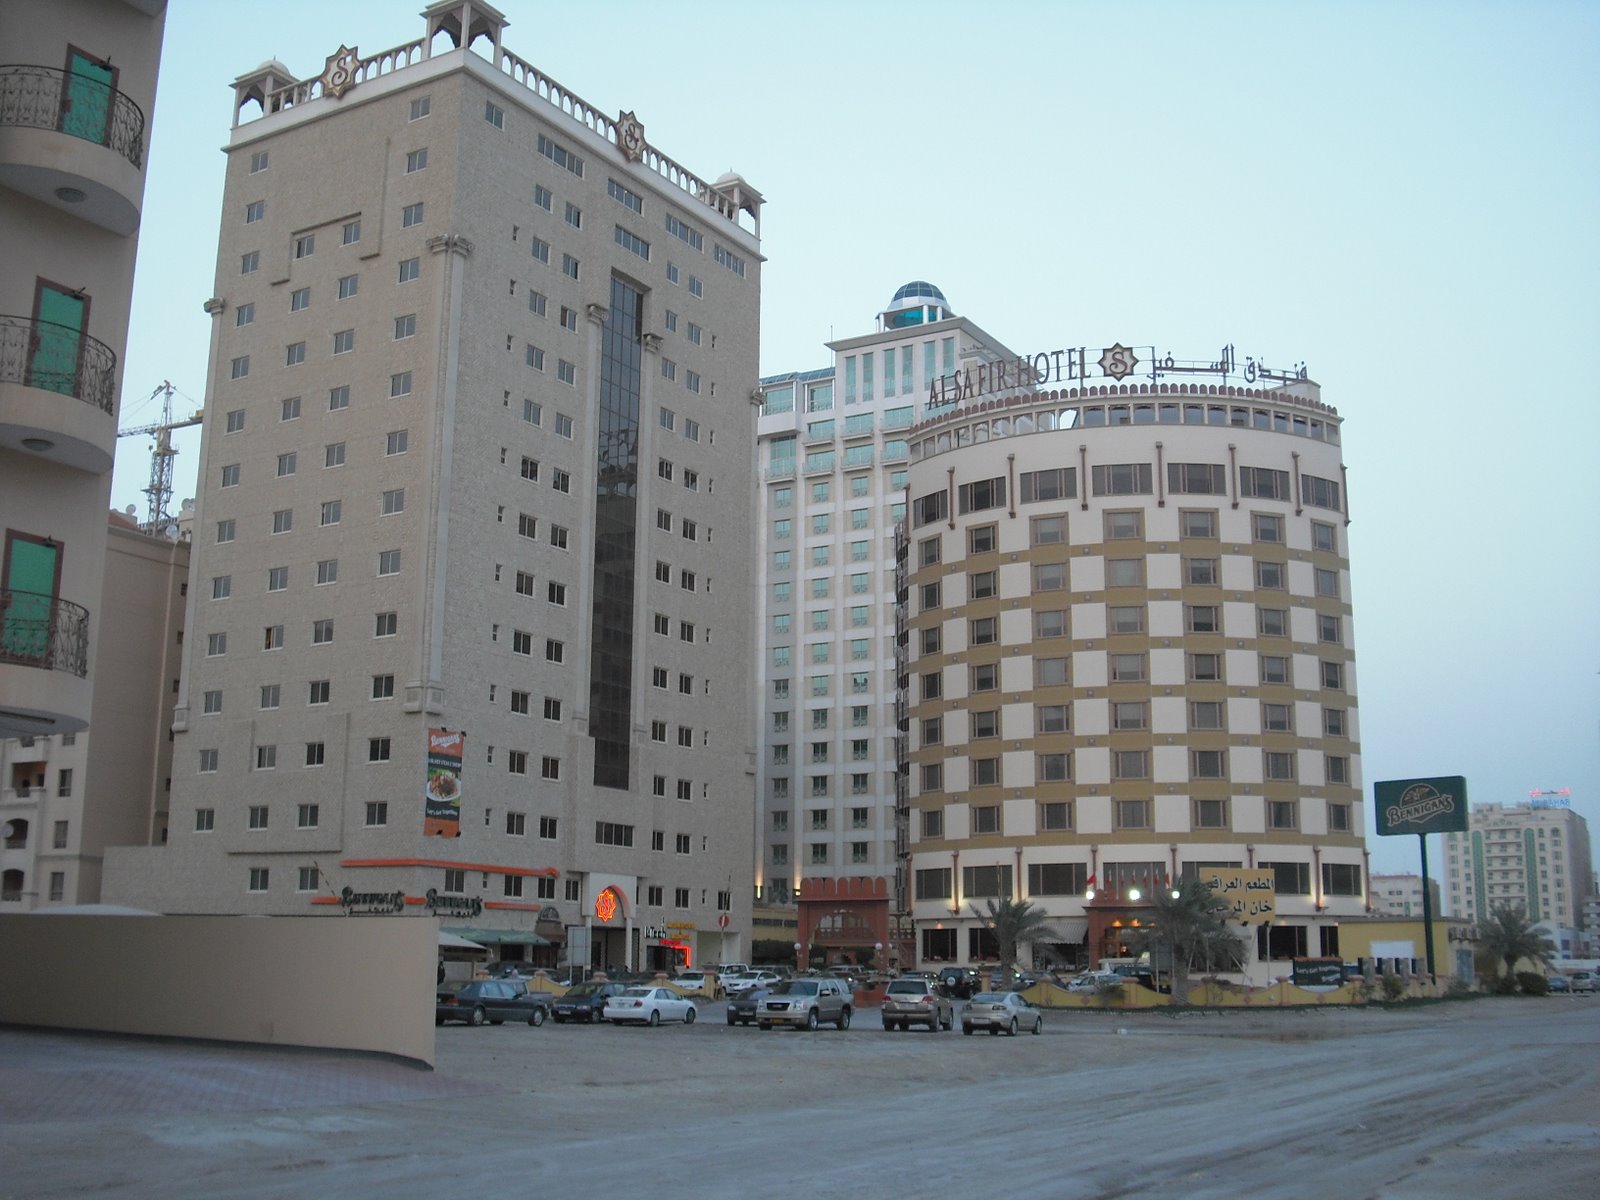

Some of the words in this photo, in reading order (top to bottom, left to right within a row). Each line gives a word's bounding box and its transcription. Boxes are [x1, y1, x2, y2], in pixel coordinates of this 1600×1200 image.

[953, 360, 1013, 402] SAFIR
[1014, 346, 1092, 389] HOTEL
[1109, 351, 1129, 375] S
[1146, 343, 1236, 380] السفير
[1244, 356, 1308, 384] فندق
[1386, 794, 1455, 827] BENNIGAN'S
[1245, 877, 1275, 893] المطعم
[1250, 900, 1273, 916] خان
